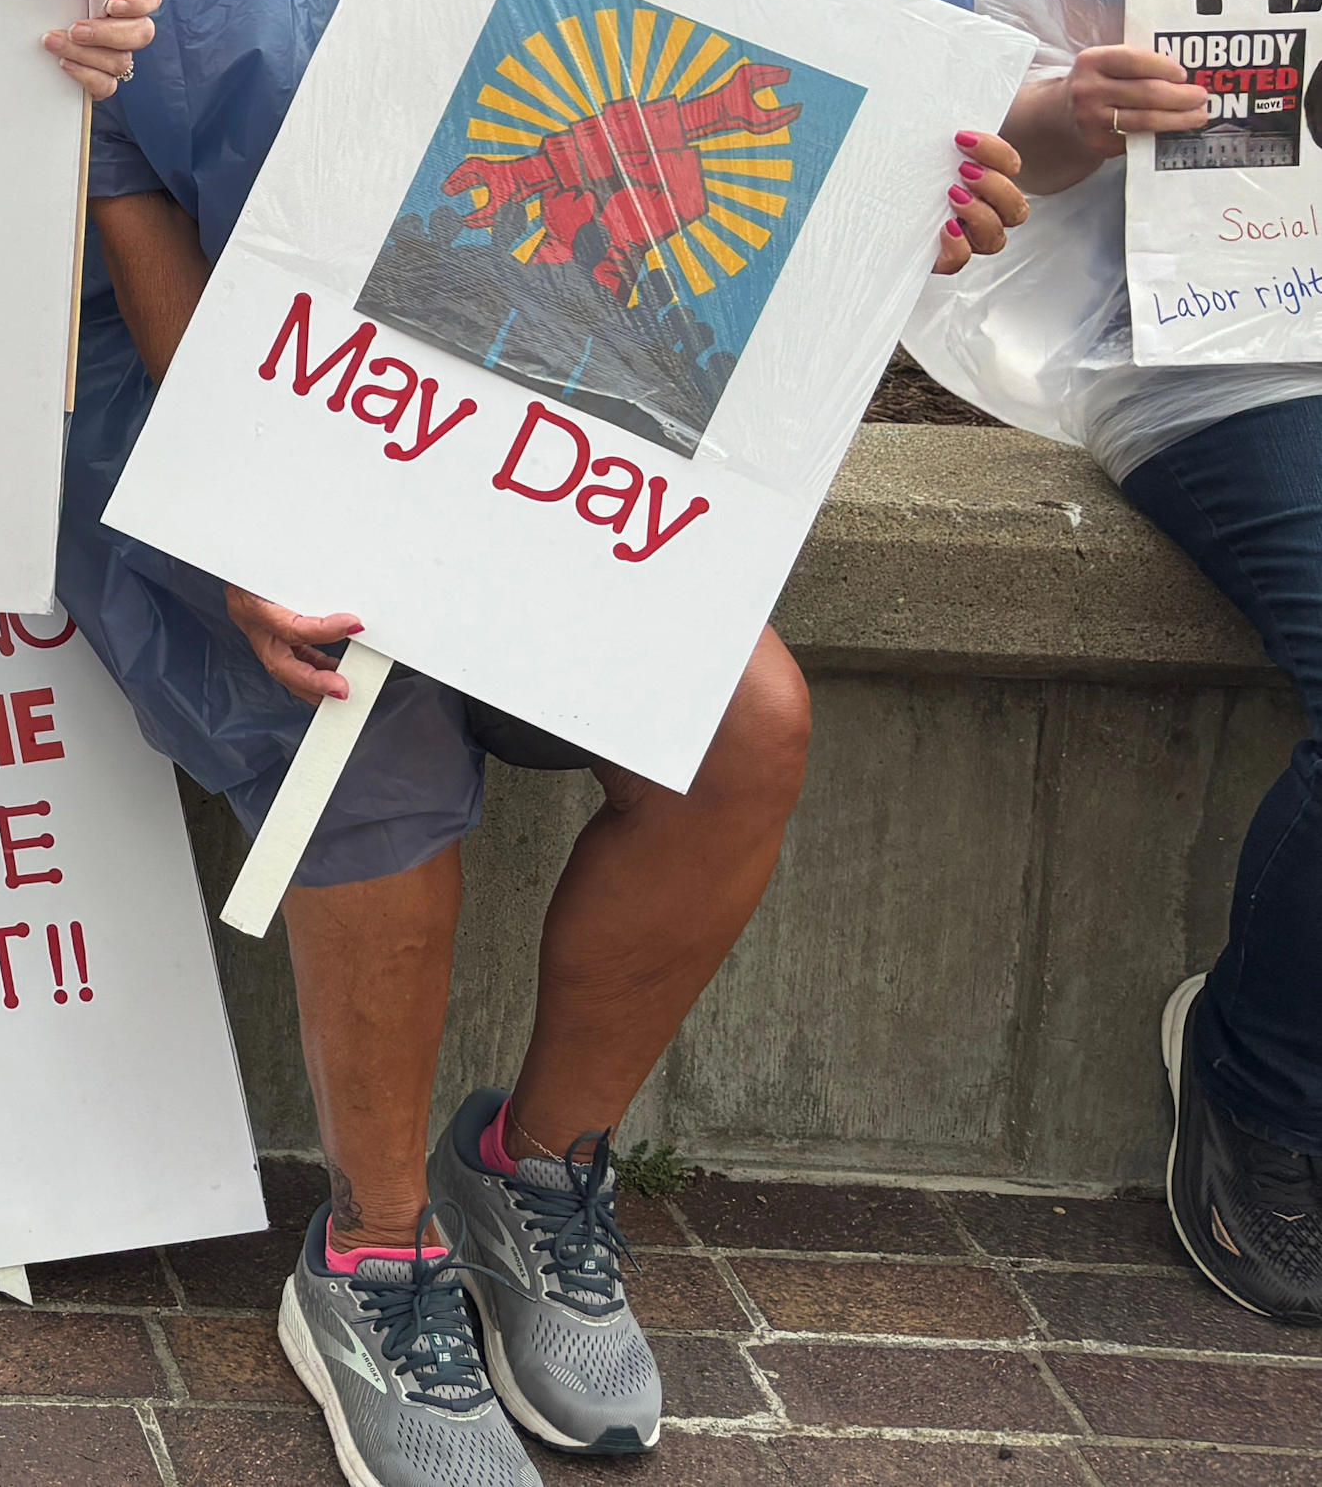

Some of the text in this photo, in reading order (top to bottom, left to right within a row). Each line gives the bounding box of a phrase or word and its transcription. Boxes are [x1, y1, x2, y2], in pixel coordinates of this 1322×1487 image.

[1157, 33, 1298, 69] NOBODY
[1194, 66, 1299, 92] ECTED
[1218, 204, 1319, 242] Social
[1154, 282, 1241, 326] Labor
[258, 292, 710, 563] May Day
[361, 1351, 382, 1384] BROOKS
